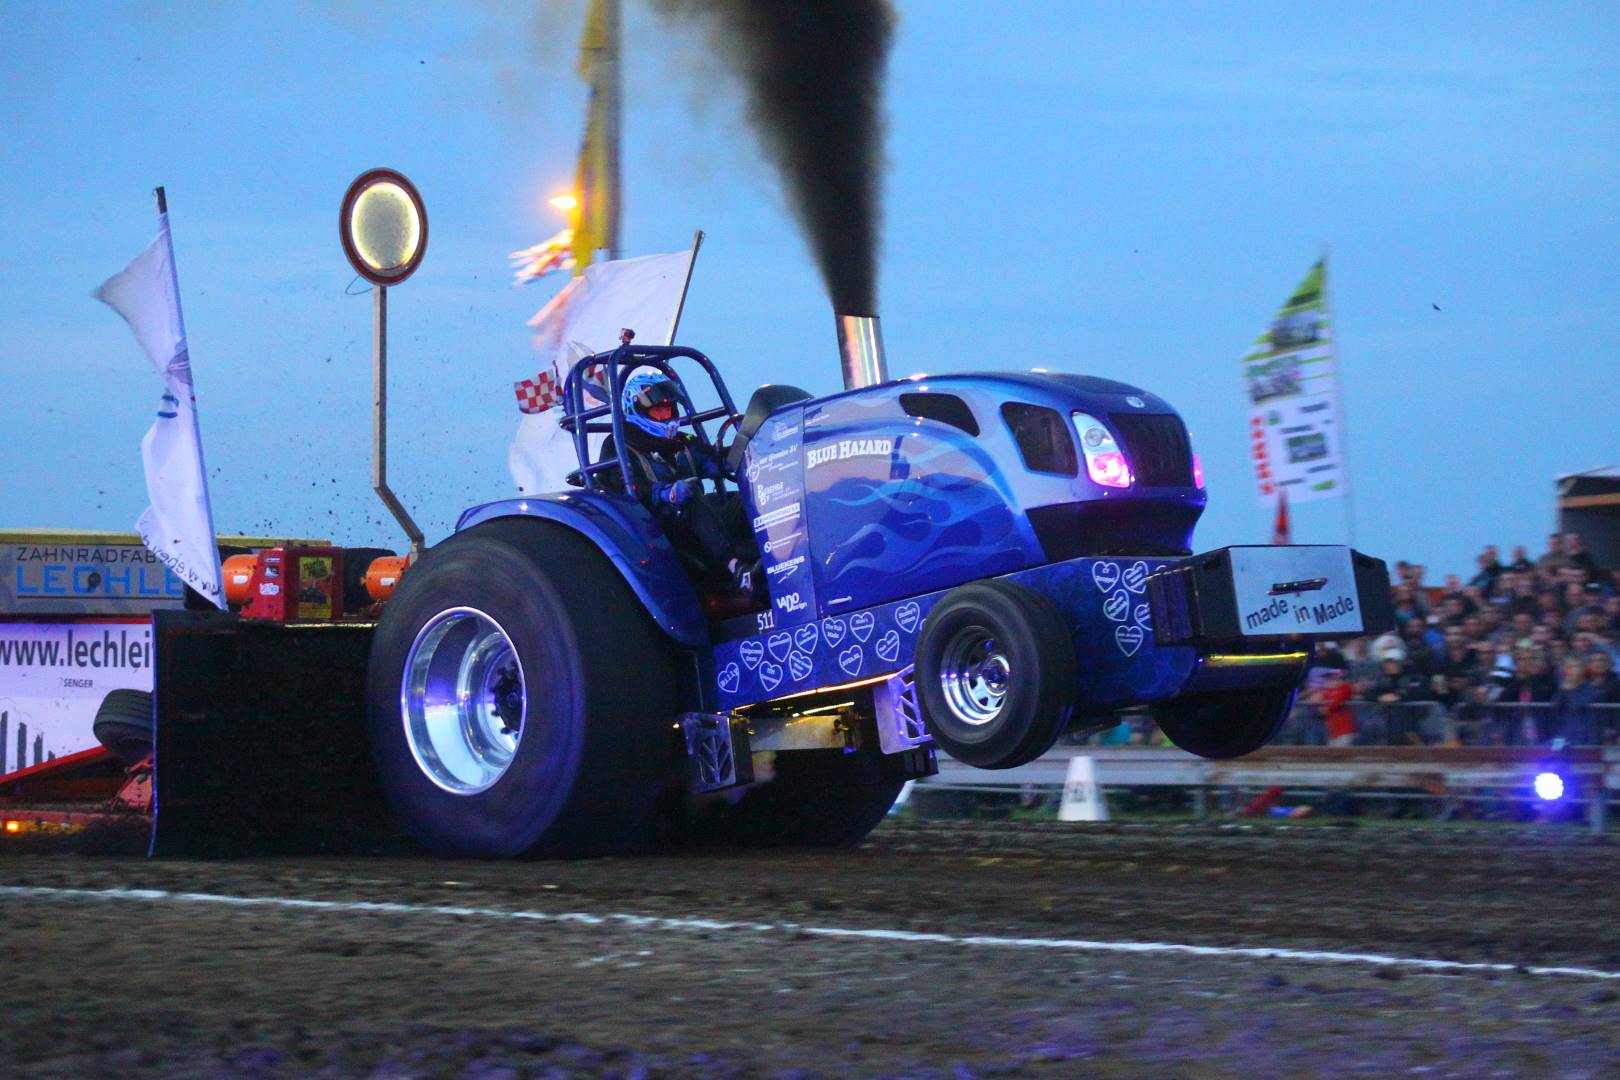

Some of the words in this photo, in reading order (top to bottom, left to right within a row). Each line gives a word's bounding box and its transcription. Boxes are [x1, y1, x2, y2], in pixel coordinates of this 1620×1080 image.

[807, 444, 838, 469] BLUE
[838, 439, 892, 460] HAZARD
[16, 546, 163, 564] ZAHNRADFAB
[776, 592, 800, 609] VADO
[757, 611, 775, 631] 511
[1246, 598, 1289, 629] made
[1292, 605, 1311, 624] in
[1313, 596, 1354, 625] Made
[63, 678, 93, 688] SENGER
